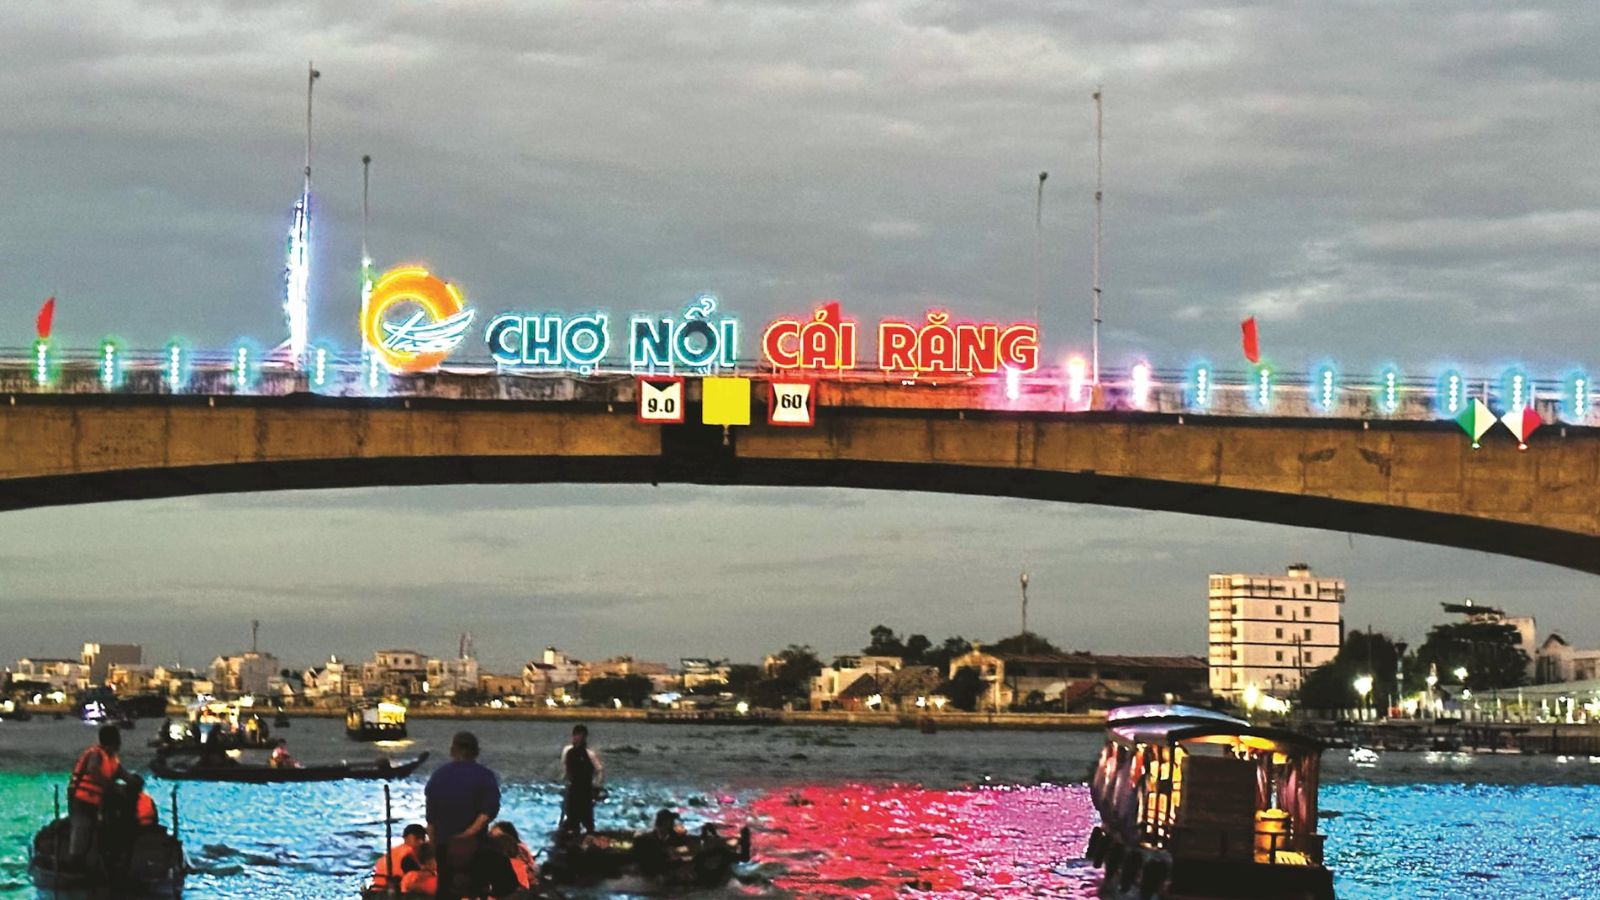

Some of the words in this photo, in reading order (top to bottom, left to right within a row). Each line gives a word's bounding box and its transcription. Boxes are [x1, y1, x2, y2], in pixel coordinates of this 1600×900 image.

[485, 314, 610, 375] CHỢ
[630, 297, 738, 367] NỔI
[763, 309, 856, 370] CÁI
[879, 313, 1039, 373] RĂNG
[647, 398, 675, 413] 9.0
[781, 393, 802, 409] 60
